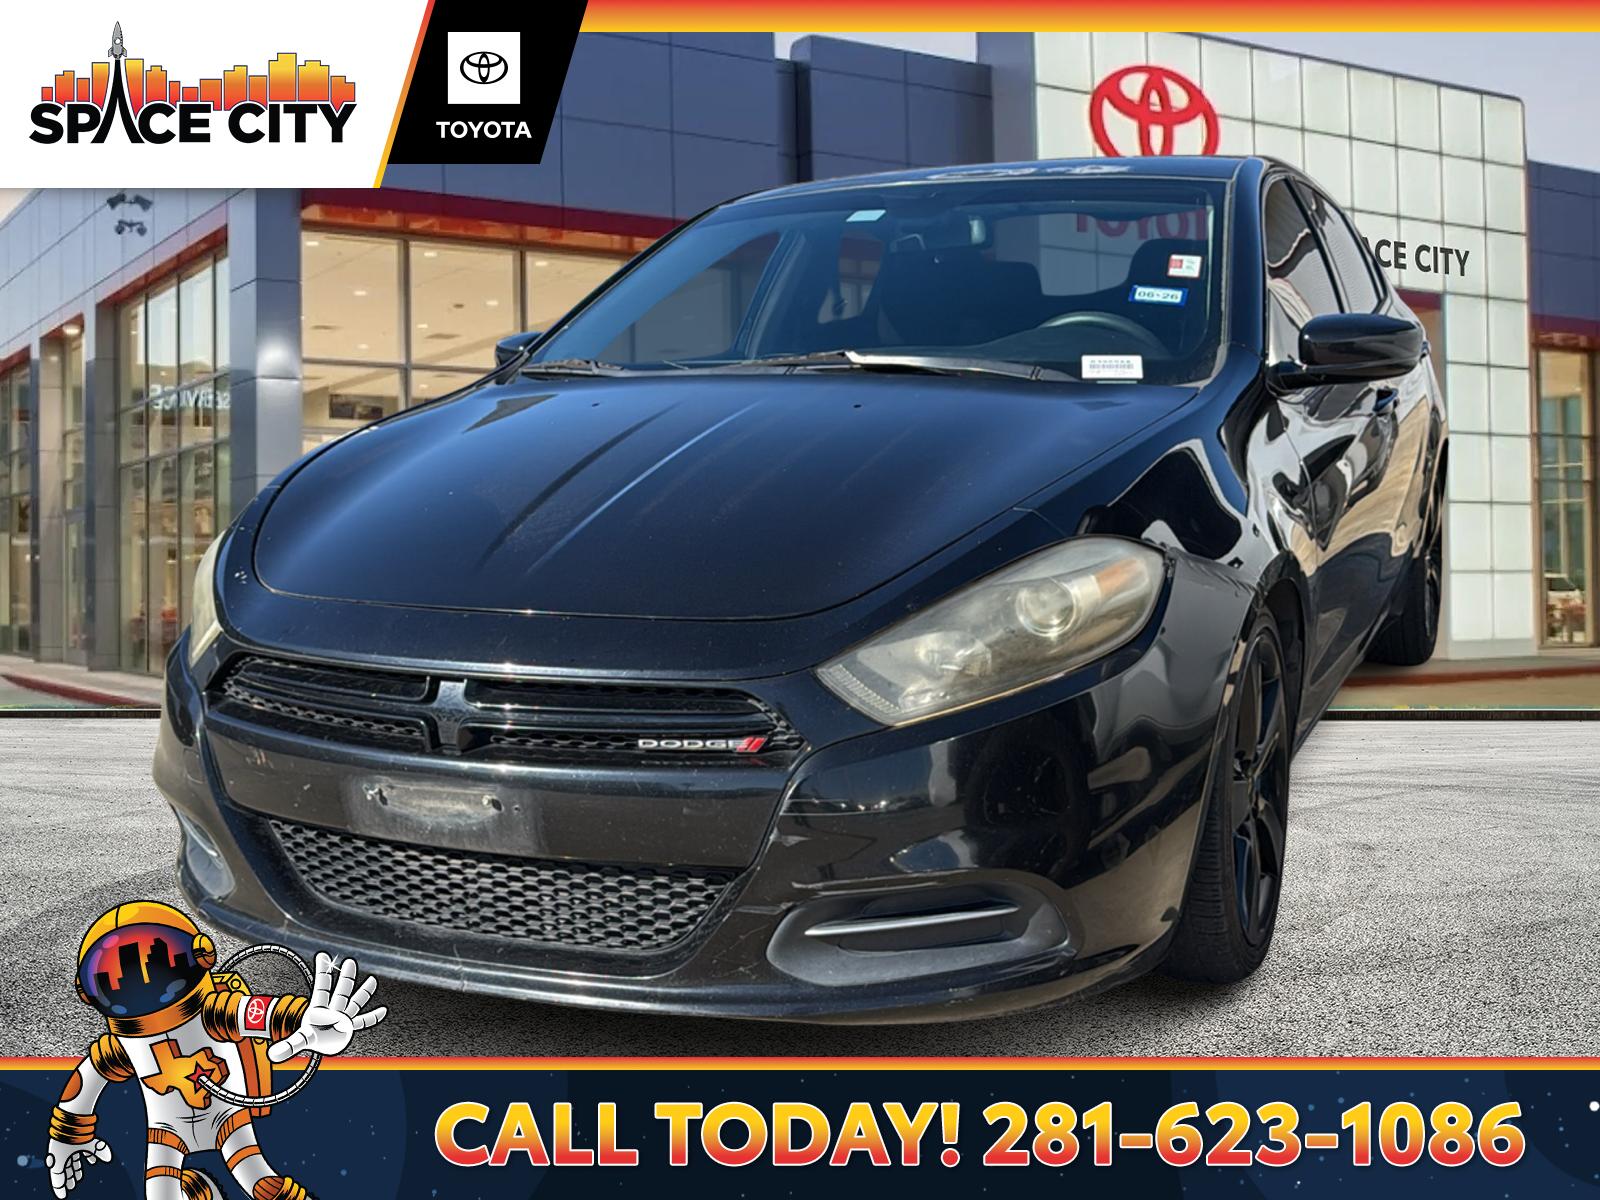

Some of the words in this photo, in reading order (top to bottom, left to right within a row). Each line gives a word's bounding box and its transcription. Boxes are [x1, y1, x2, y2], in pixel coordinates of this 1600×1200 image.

[1414, 243, 1470, 277] CITY
[1137, 290, 1179, 300] 06-26
[637, 738, 747, 751] DODGE
